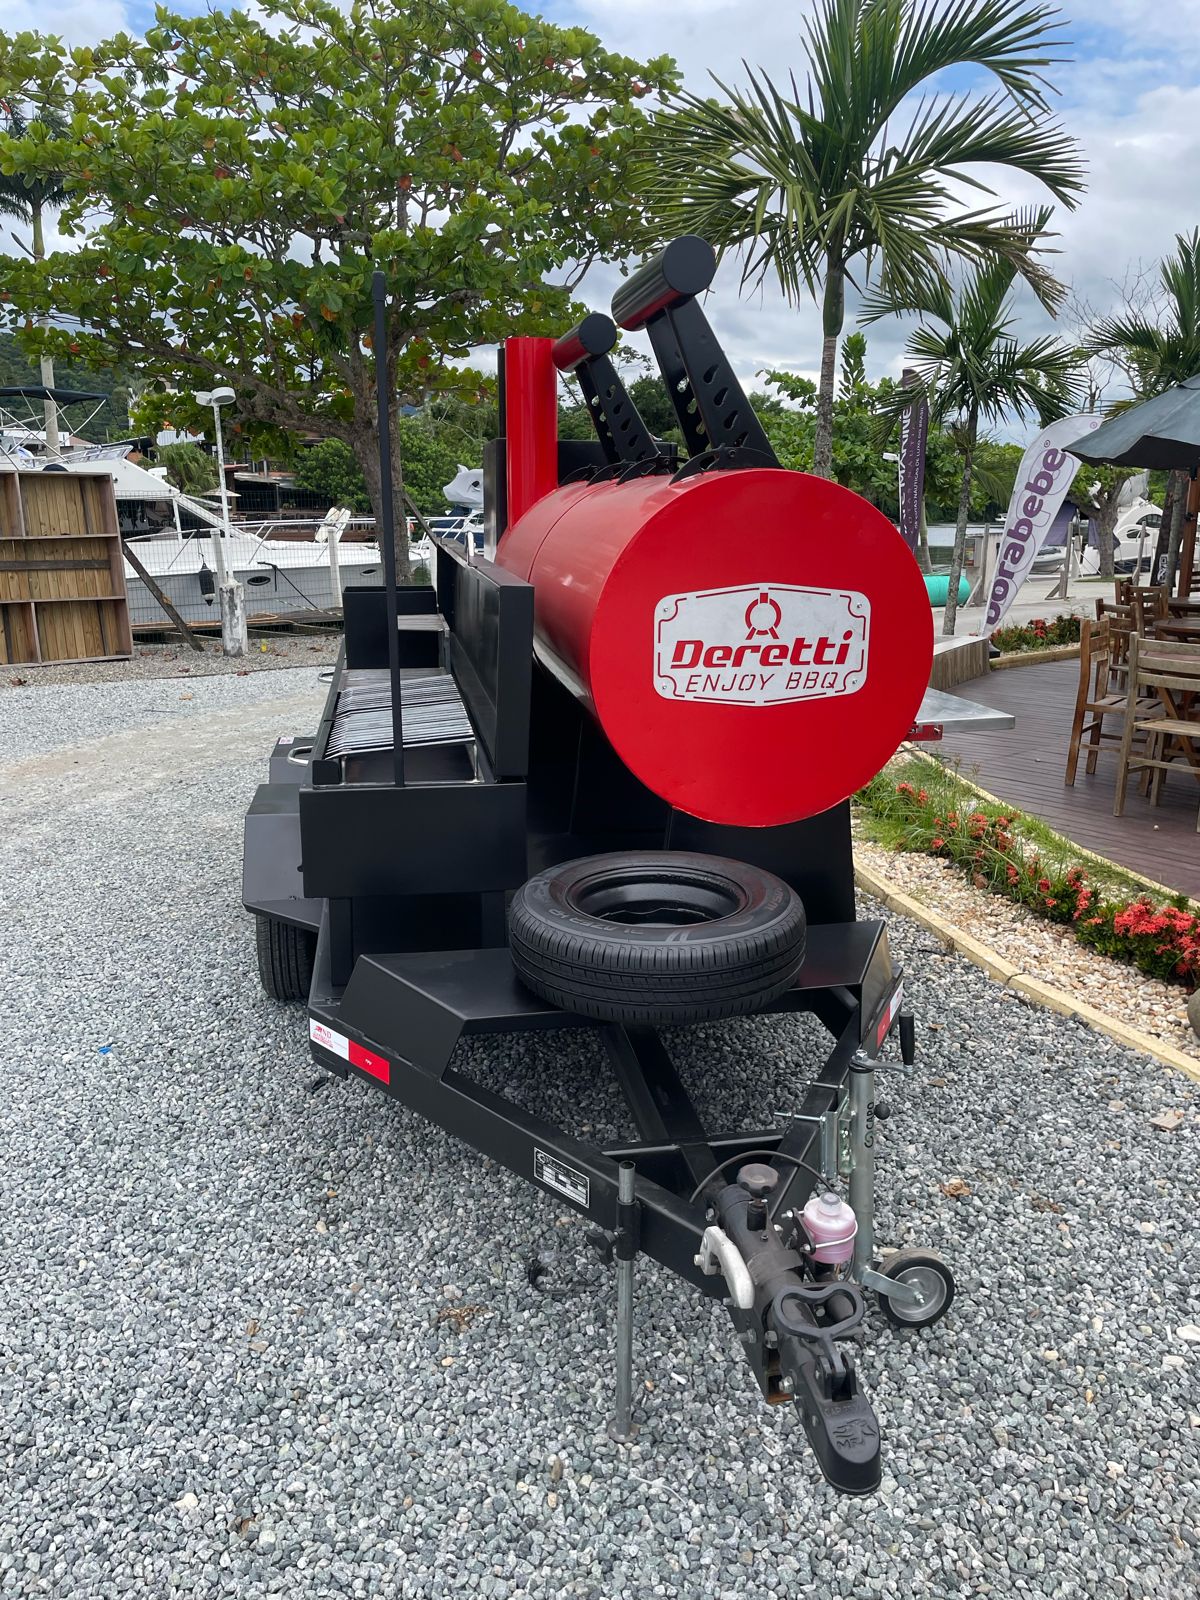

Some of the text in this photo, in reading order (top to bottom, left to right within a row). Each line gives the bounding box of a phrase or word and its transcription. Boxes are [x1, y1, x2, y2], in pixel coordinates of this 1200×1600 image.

[670, 629, 853, 669] Deretti
[685, 671, 839, 692] ENJOY BBQ
[866, 1101, 874, 1130] CAPO
